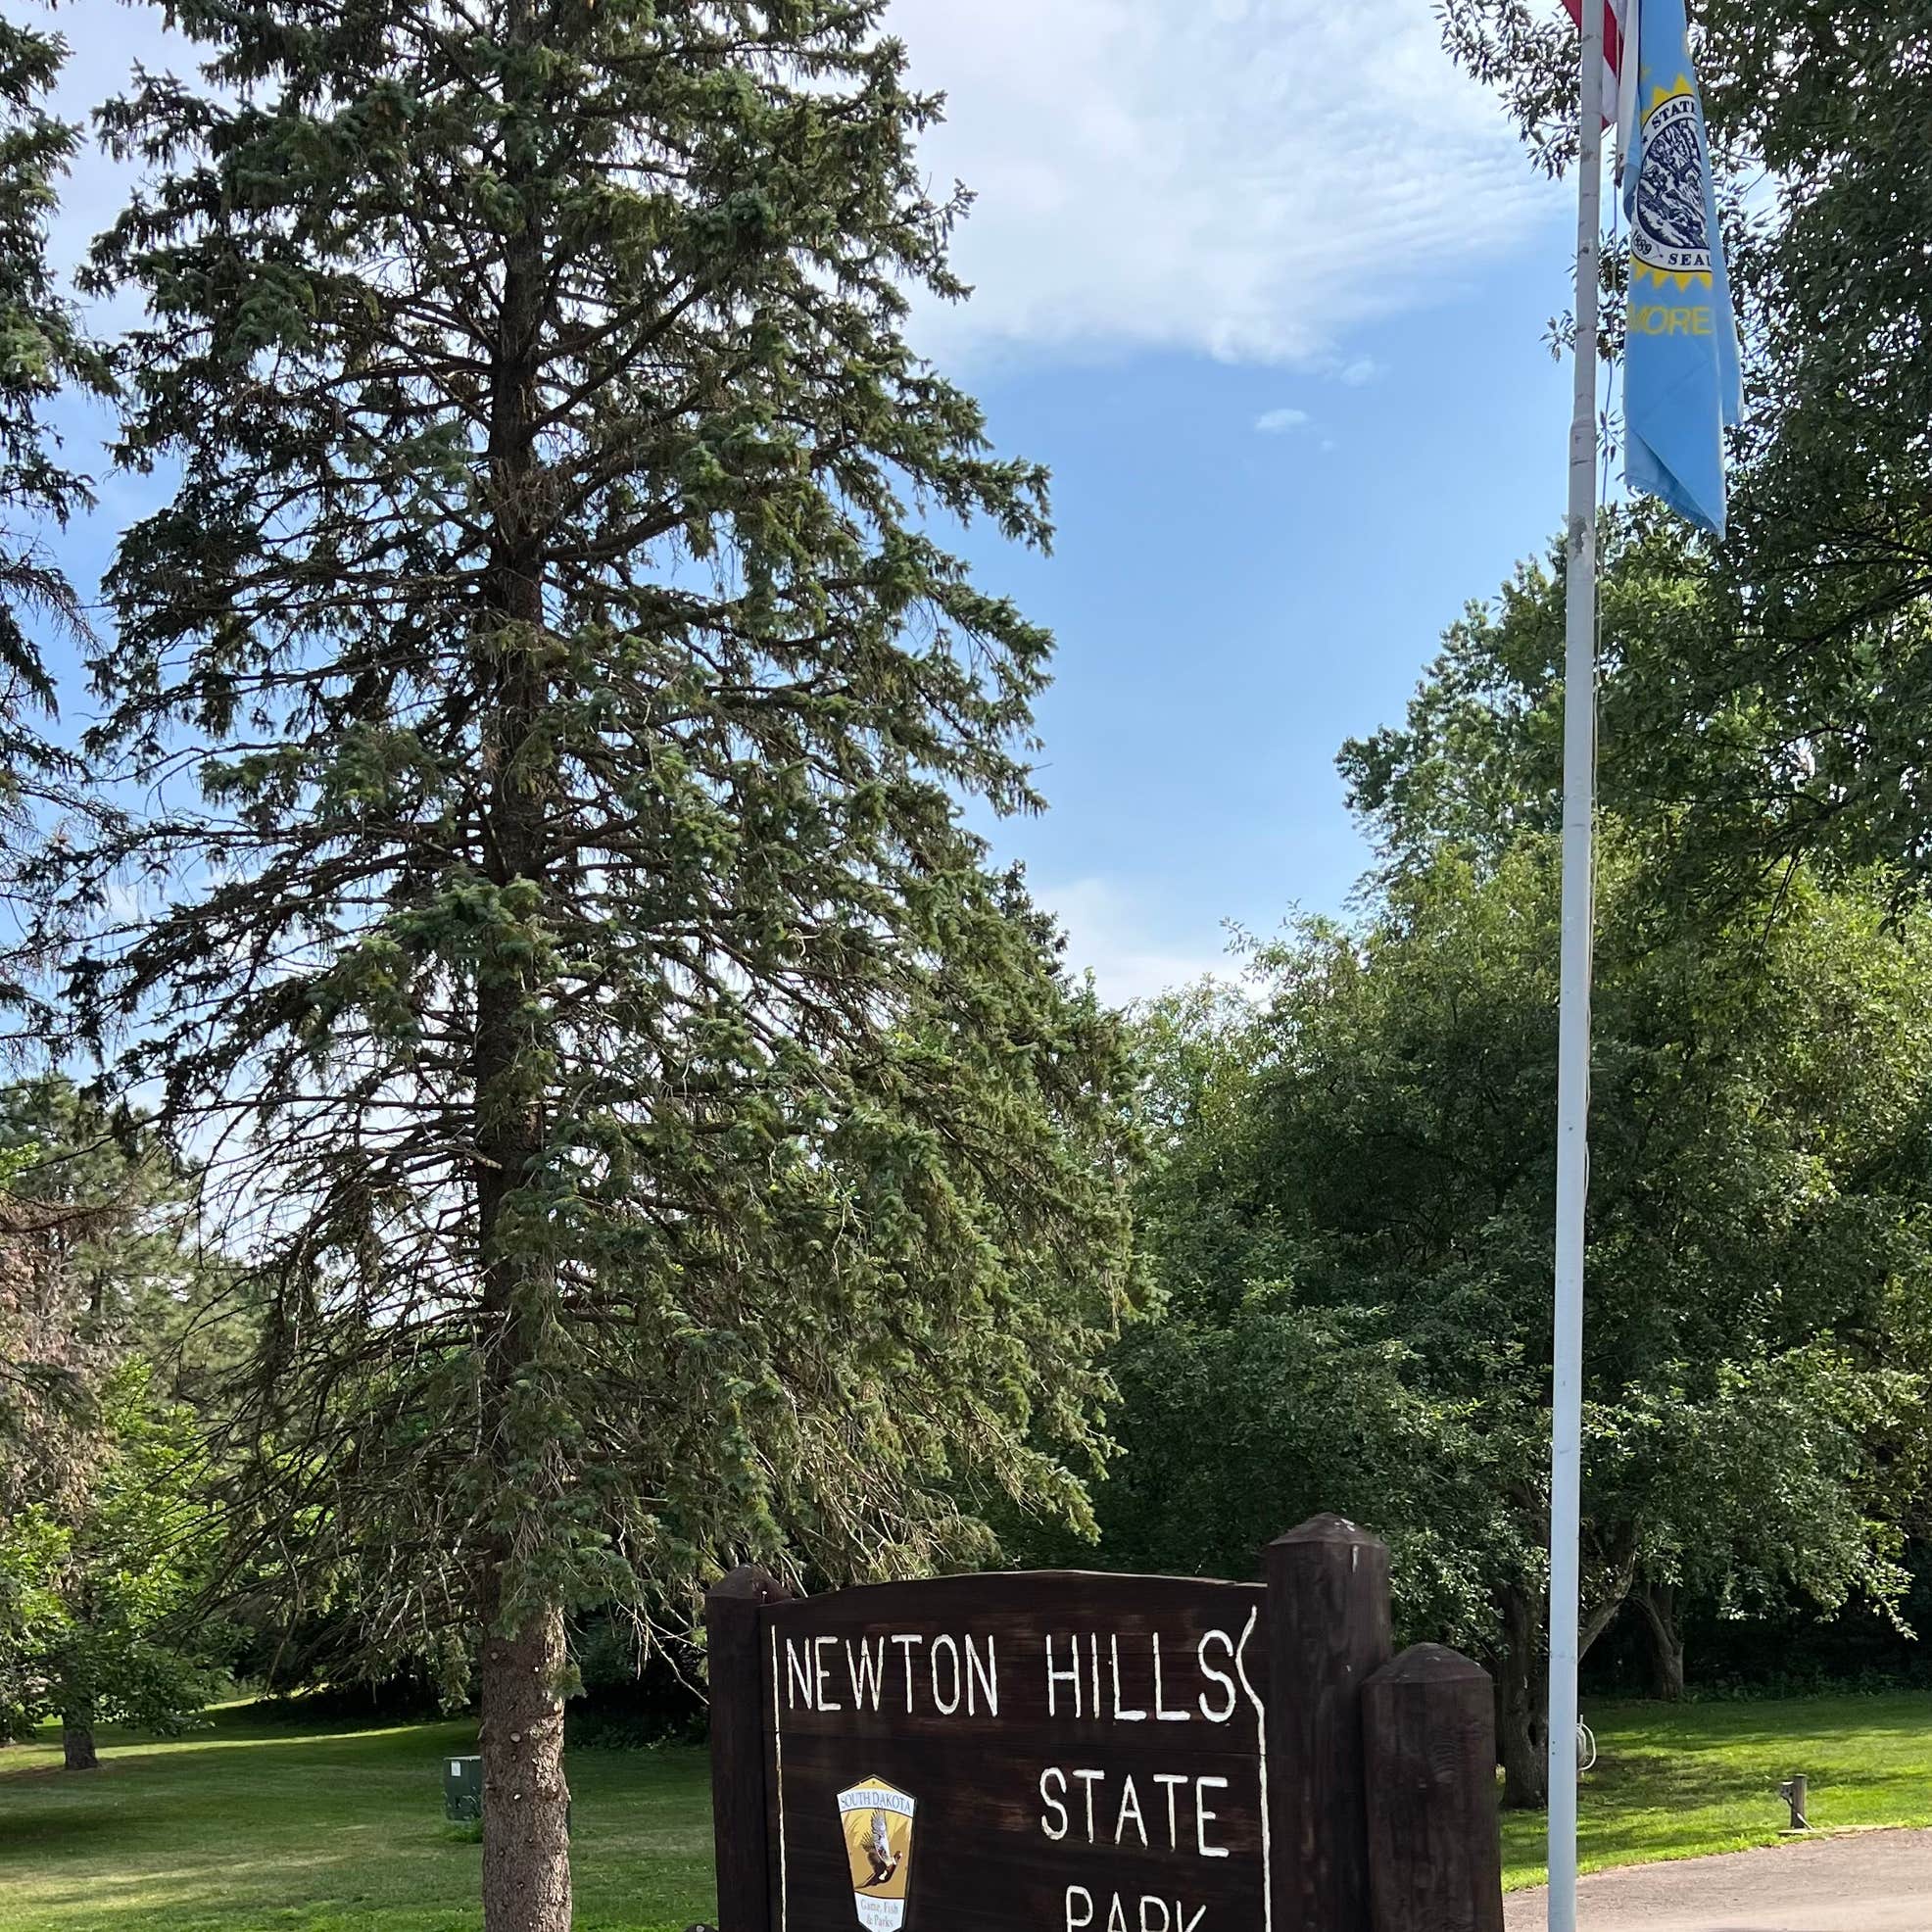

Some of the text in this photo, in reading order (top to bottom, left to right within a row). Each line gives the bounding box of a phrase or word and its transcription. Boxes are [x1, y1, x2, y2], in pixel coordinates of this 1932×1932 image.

[786, 1628, 1236, 1722] NEWTON HILLS
[841, 1791, 911, 1811] SOUTH DAKOTA
[1039, 1766, 1230, 1858] STATE
[884, 1901, 899, 1914] Fish
[874, 1913, 894, 1928] Parks
